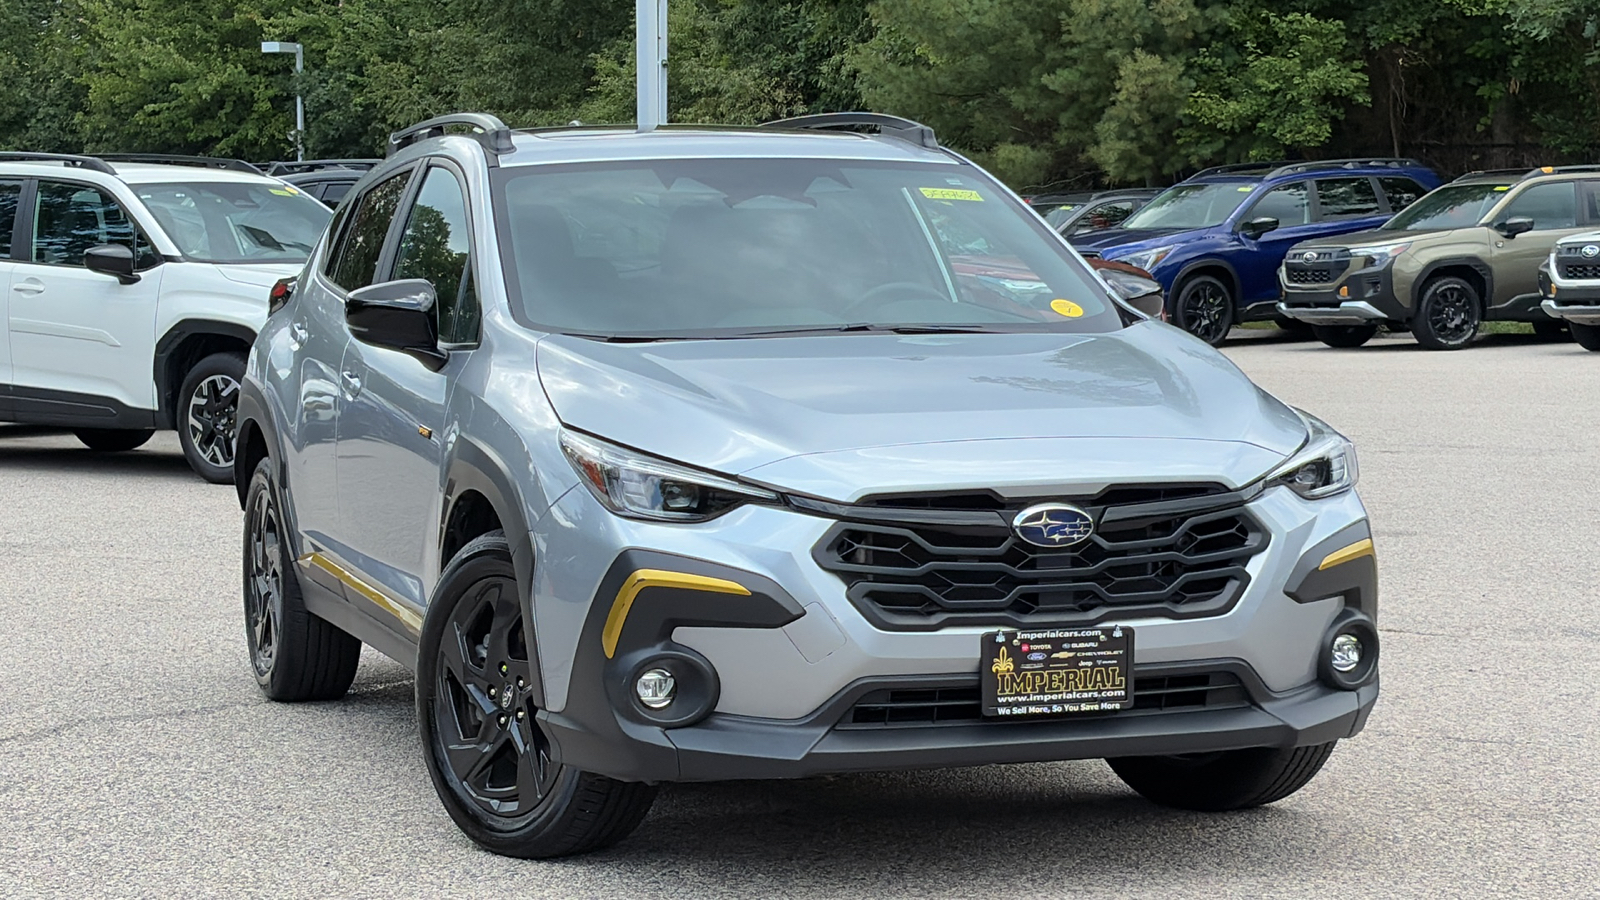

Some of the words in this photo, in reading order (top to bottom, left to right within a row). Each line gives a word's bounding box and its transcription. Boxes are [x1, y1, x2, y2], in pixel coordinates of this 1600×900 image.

[1016, 630, 1102, 640] Imperialcars.com
[997, 667, 1125, 695] IMPERIAL
[997, 690, 1125, 703] www.imperialcars.com
[997, 707, 1011, 715] We
[1012, 706, 1027, 715] Sell
[1028, 705, 1050, 714] More,
[1052, 704, 1063, 712] So
[1064, 704, 1079, 712] You
[1080, 703, 1099, 711] Save
[1100, 702, 1120, 710] More
